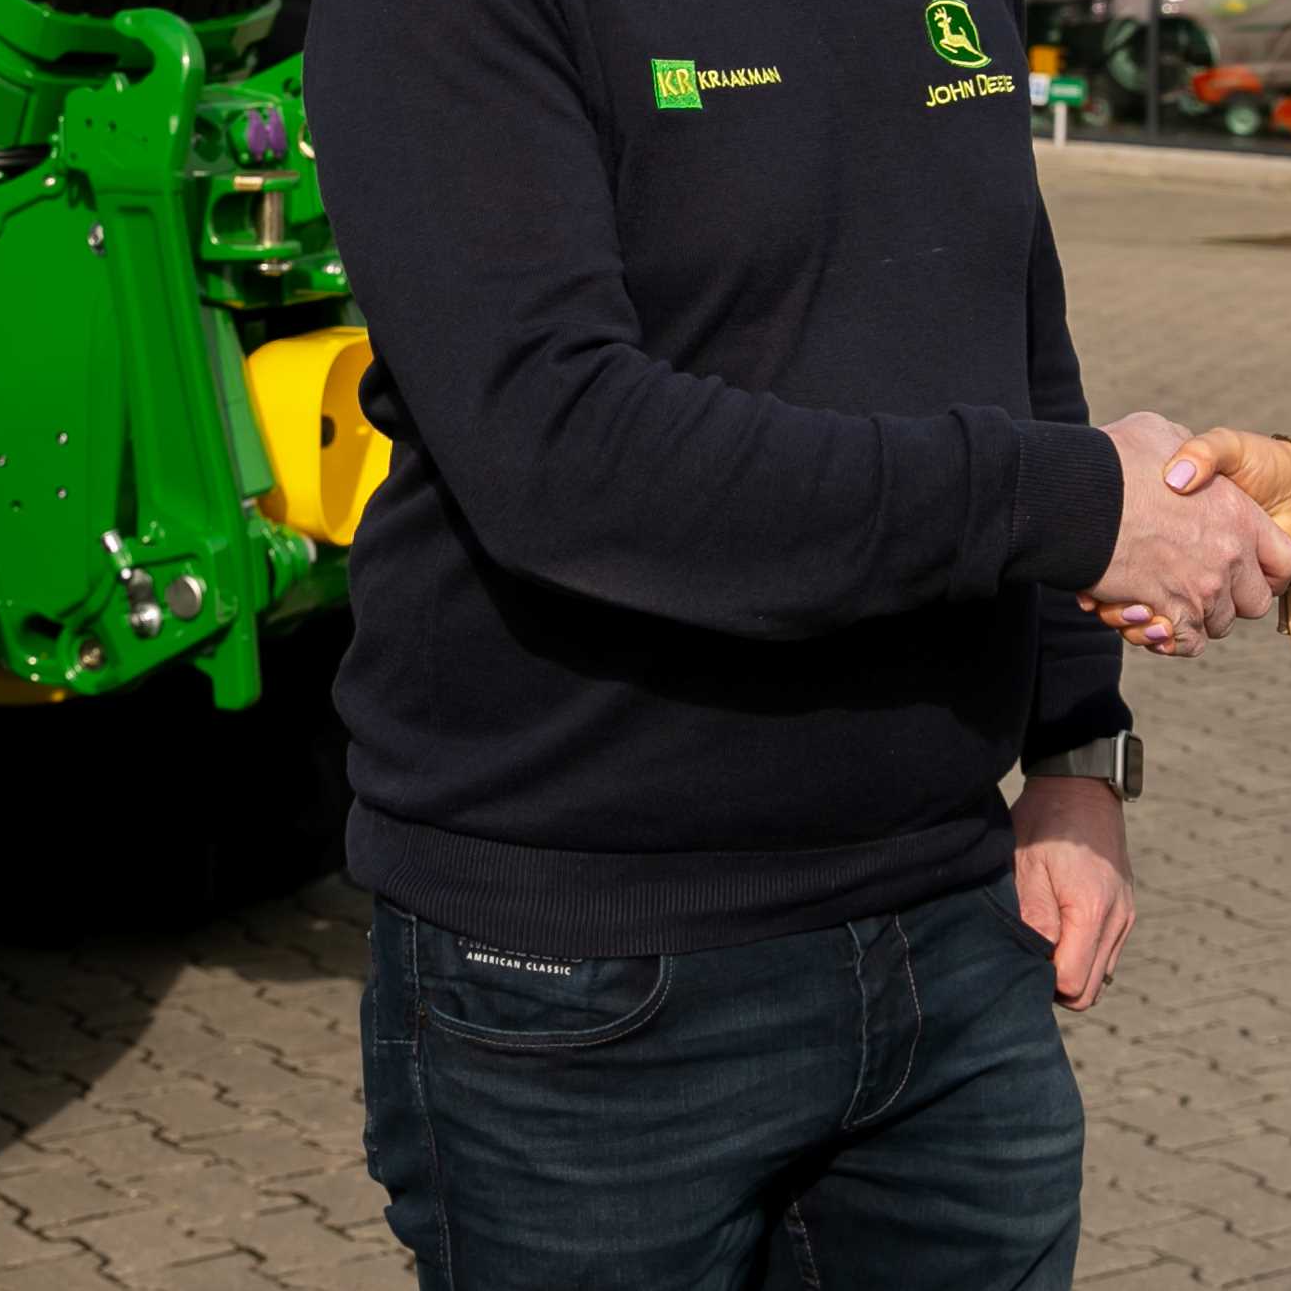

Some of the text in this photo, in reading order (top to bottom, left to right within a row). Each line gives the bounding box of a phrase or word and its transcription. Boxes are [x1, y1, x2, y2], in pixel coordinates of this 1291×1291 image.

[656, 65, 782, 98] KR KRAAKMAN
[926, 79, 976, 107] JOHN
[466, 951, 572, 976] AMERICAN CLASSIC
